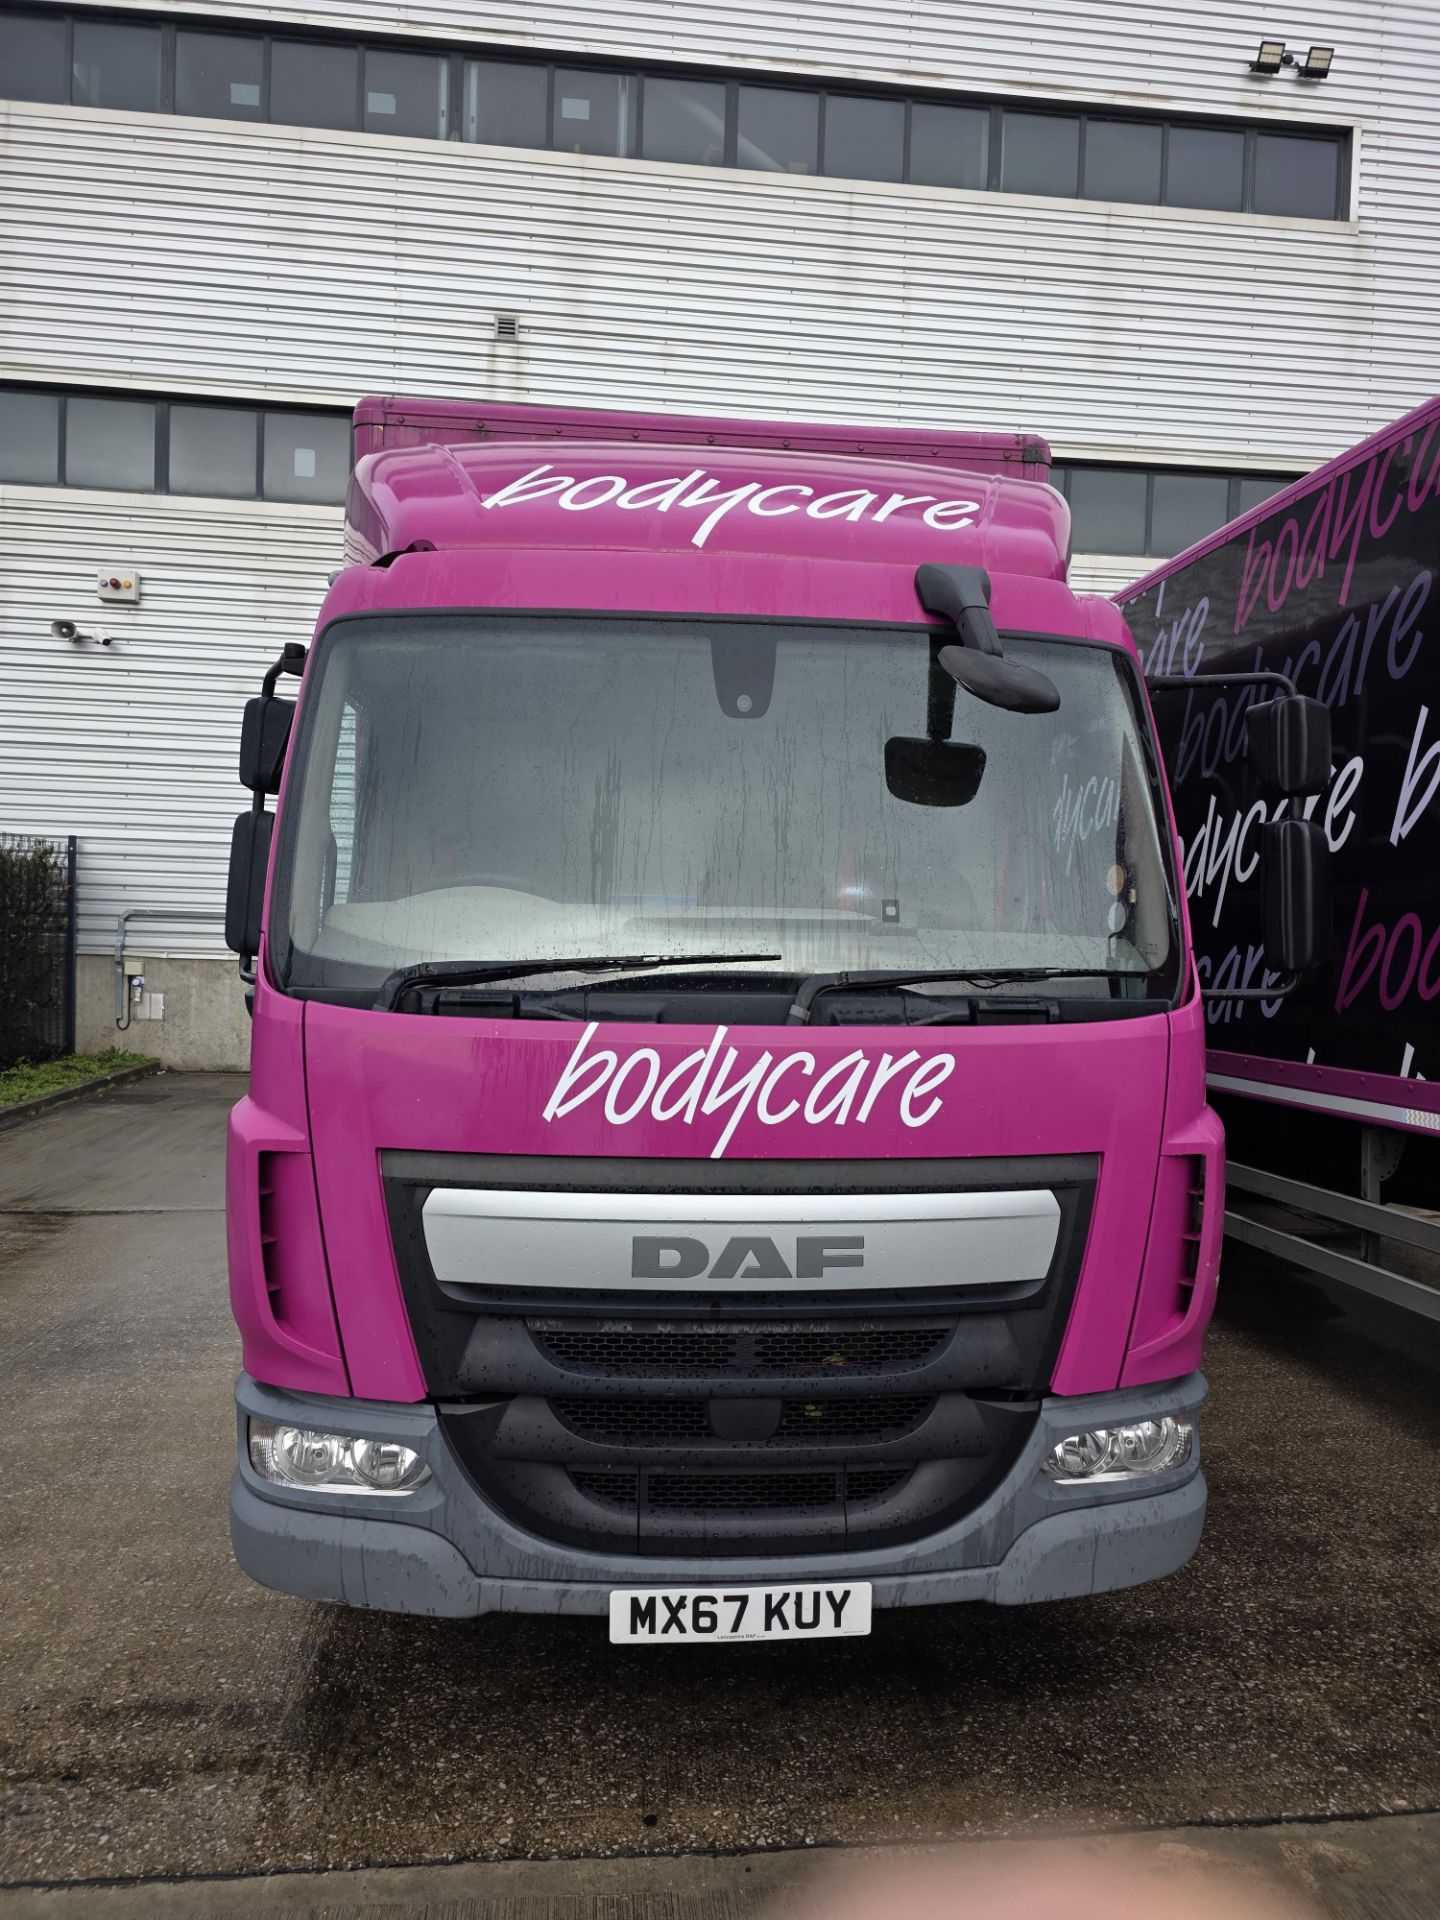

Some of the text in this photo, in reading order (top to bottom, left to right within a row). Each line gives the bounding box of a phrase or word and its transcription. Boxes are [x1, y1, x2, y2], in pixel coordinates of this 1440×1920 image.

[481, 464, 982, 549] bodycare
[1137, 596, 1210, 679] are
[542, 1022, 956, 1158] bodycare
[631, 1236, 865, 1279] DAF
[629, 1589, 852, 1635] MX67 KUY
